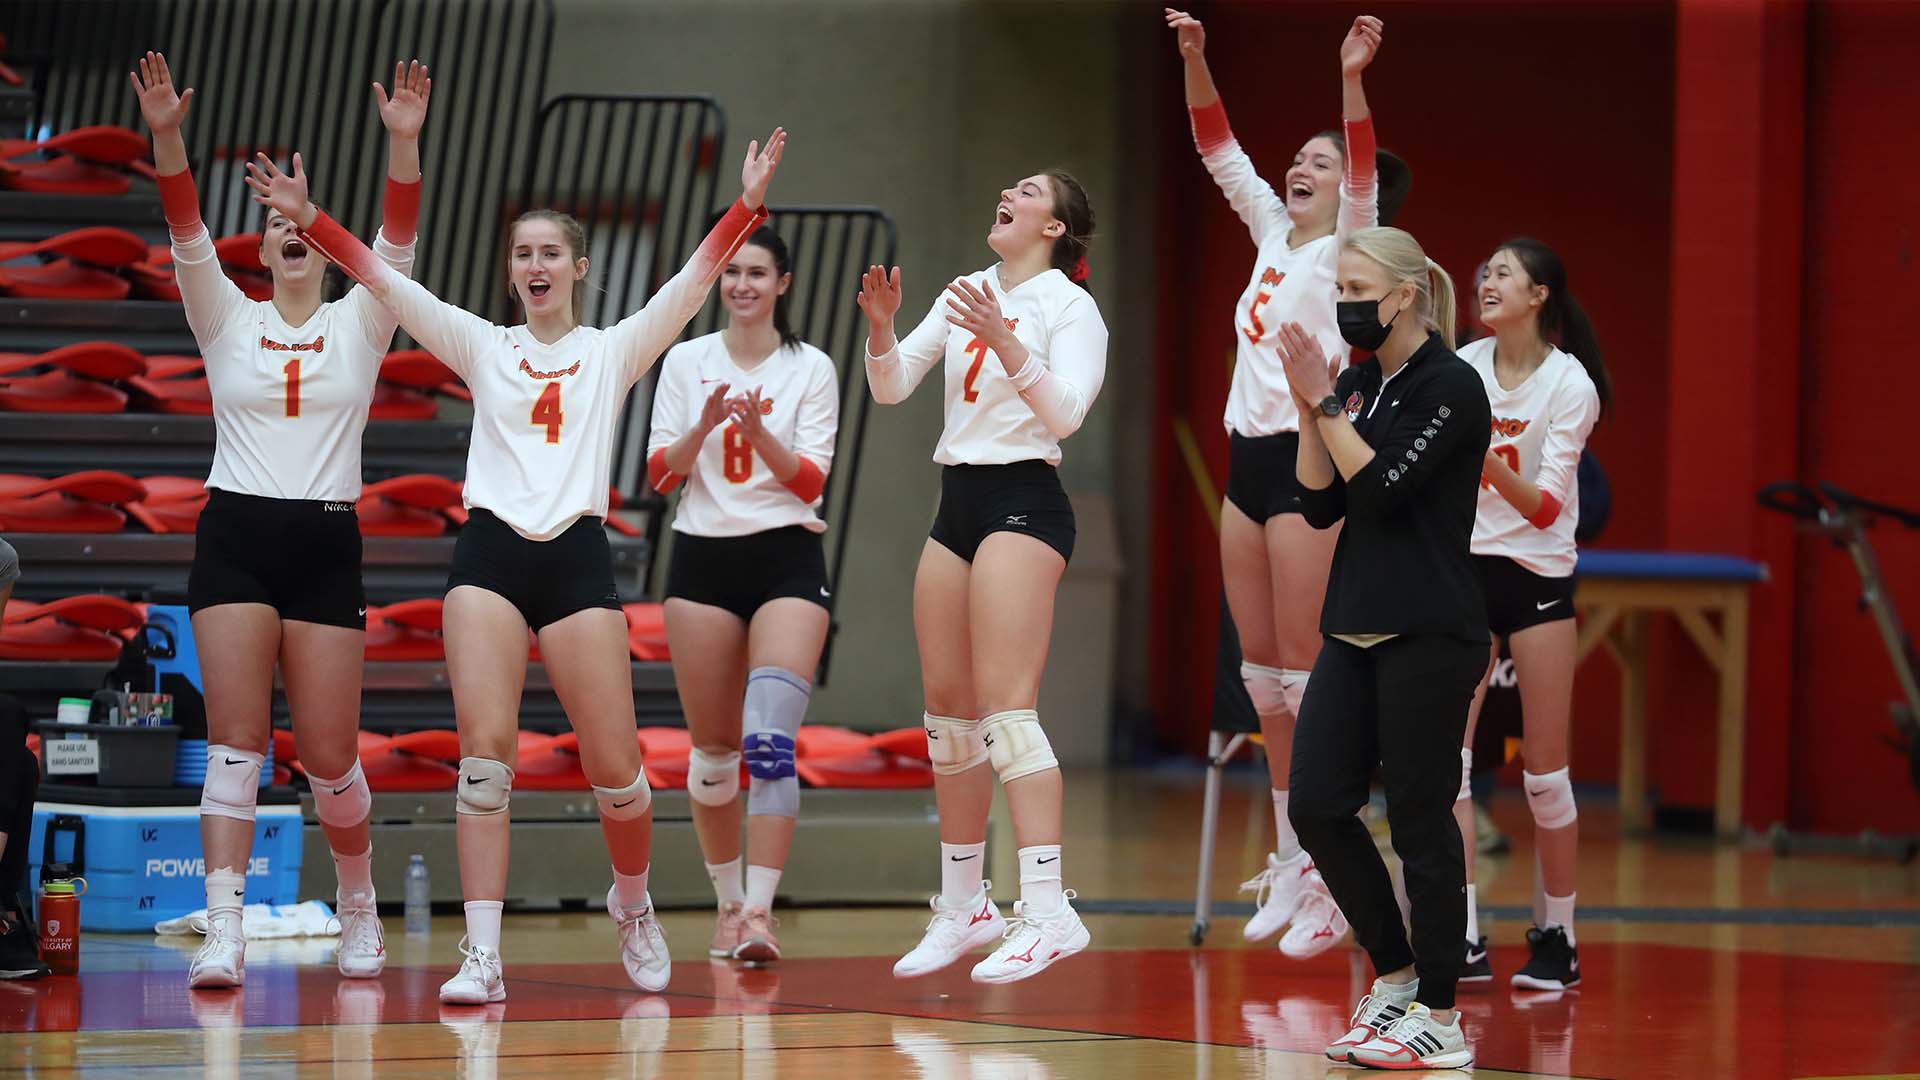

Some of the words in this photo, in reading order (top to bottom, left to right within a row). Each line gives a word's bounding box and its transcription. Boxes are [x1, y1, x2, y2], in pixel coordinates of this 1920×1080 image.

[1242, 290, 1272, 346] 5
[963, 336, 989, 404] 2
[282, 358, 302, 419] 1
[530, 381, 565, 444] 4
[1405, 405, 1452, 462] DINOS
[723, 421, 753, 484] 8
[324, 502, 350, 512] NIKE
[57, 743, 75, 752] PLEASE
[76, 743, 87, 752] USE
[51, 757, 66, 766] HAND
[68, 756, 95, 766] SANITIZER
[141, 828, 159, 842] UC
[264, 826, 279, 839] AT
[145, 857, 270, 877] POWEDE
[139, 896, 156, 909] AT
